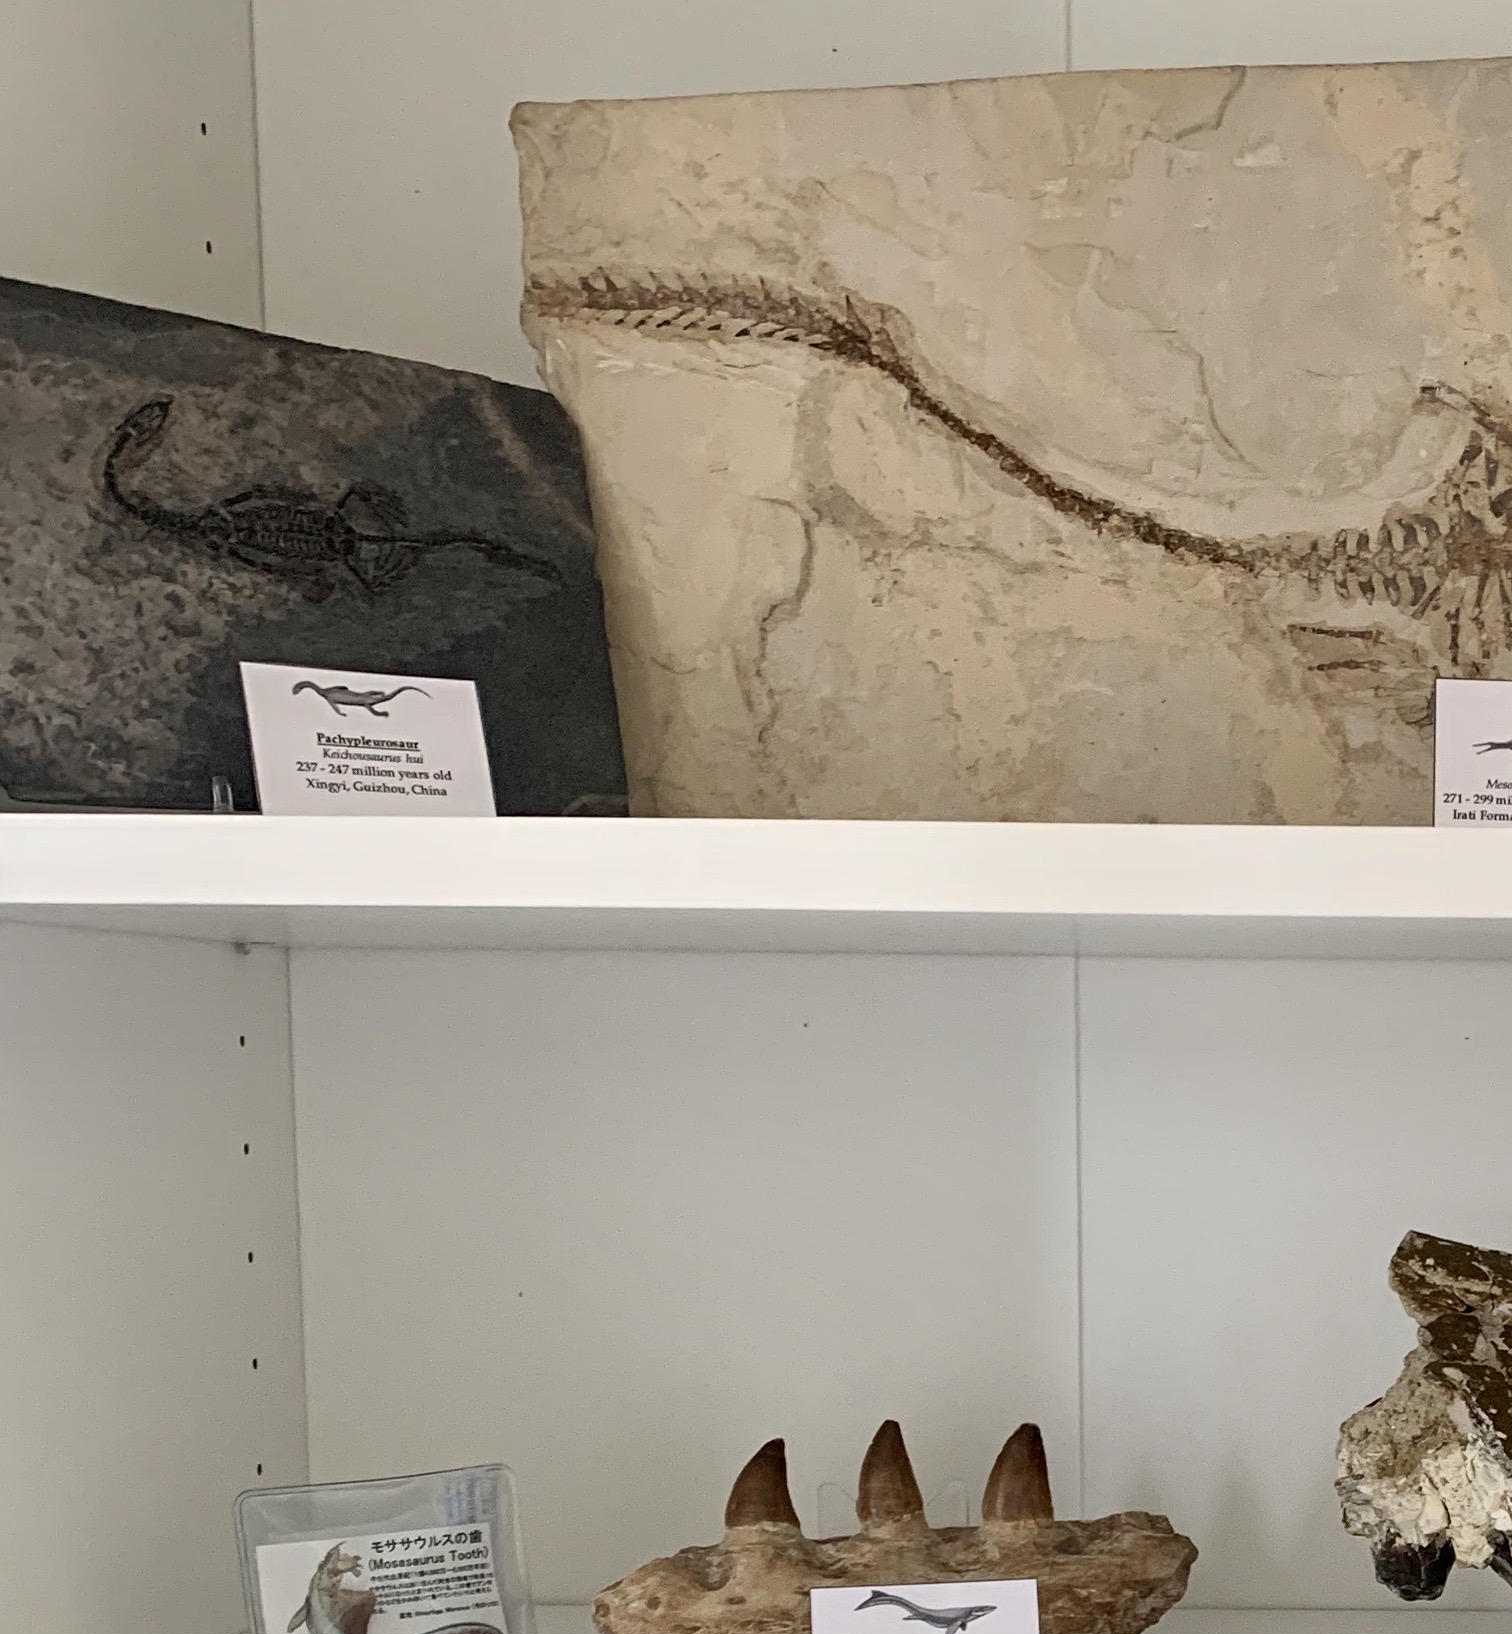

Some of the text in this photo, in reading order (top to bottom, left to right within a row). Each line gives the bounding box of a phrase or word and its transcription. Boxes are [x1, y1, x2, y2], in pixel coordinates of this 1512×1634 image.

[317, 733, 419, 750] Pachypleurosaur
[323, 748, 423, 764] Keichousaurus hui
[296, 761, 452, 781] 237 247 million years old
[306, 778, 447, 796] Xingyi, Guizhou, China
[1443, 794, 1462, 803] 271
[1473, 794, 1493, 804] 299
[1453, 809, 1475, 820] Irati
[371, 1530, 482, 1553] モササウルスの歯
[369, 1546, 489, 1571] (Mosasaurus Tooth)
